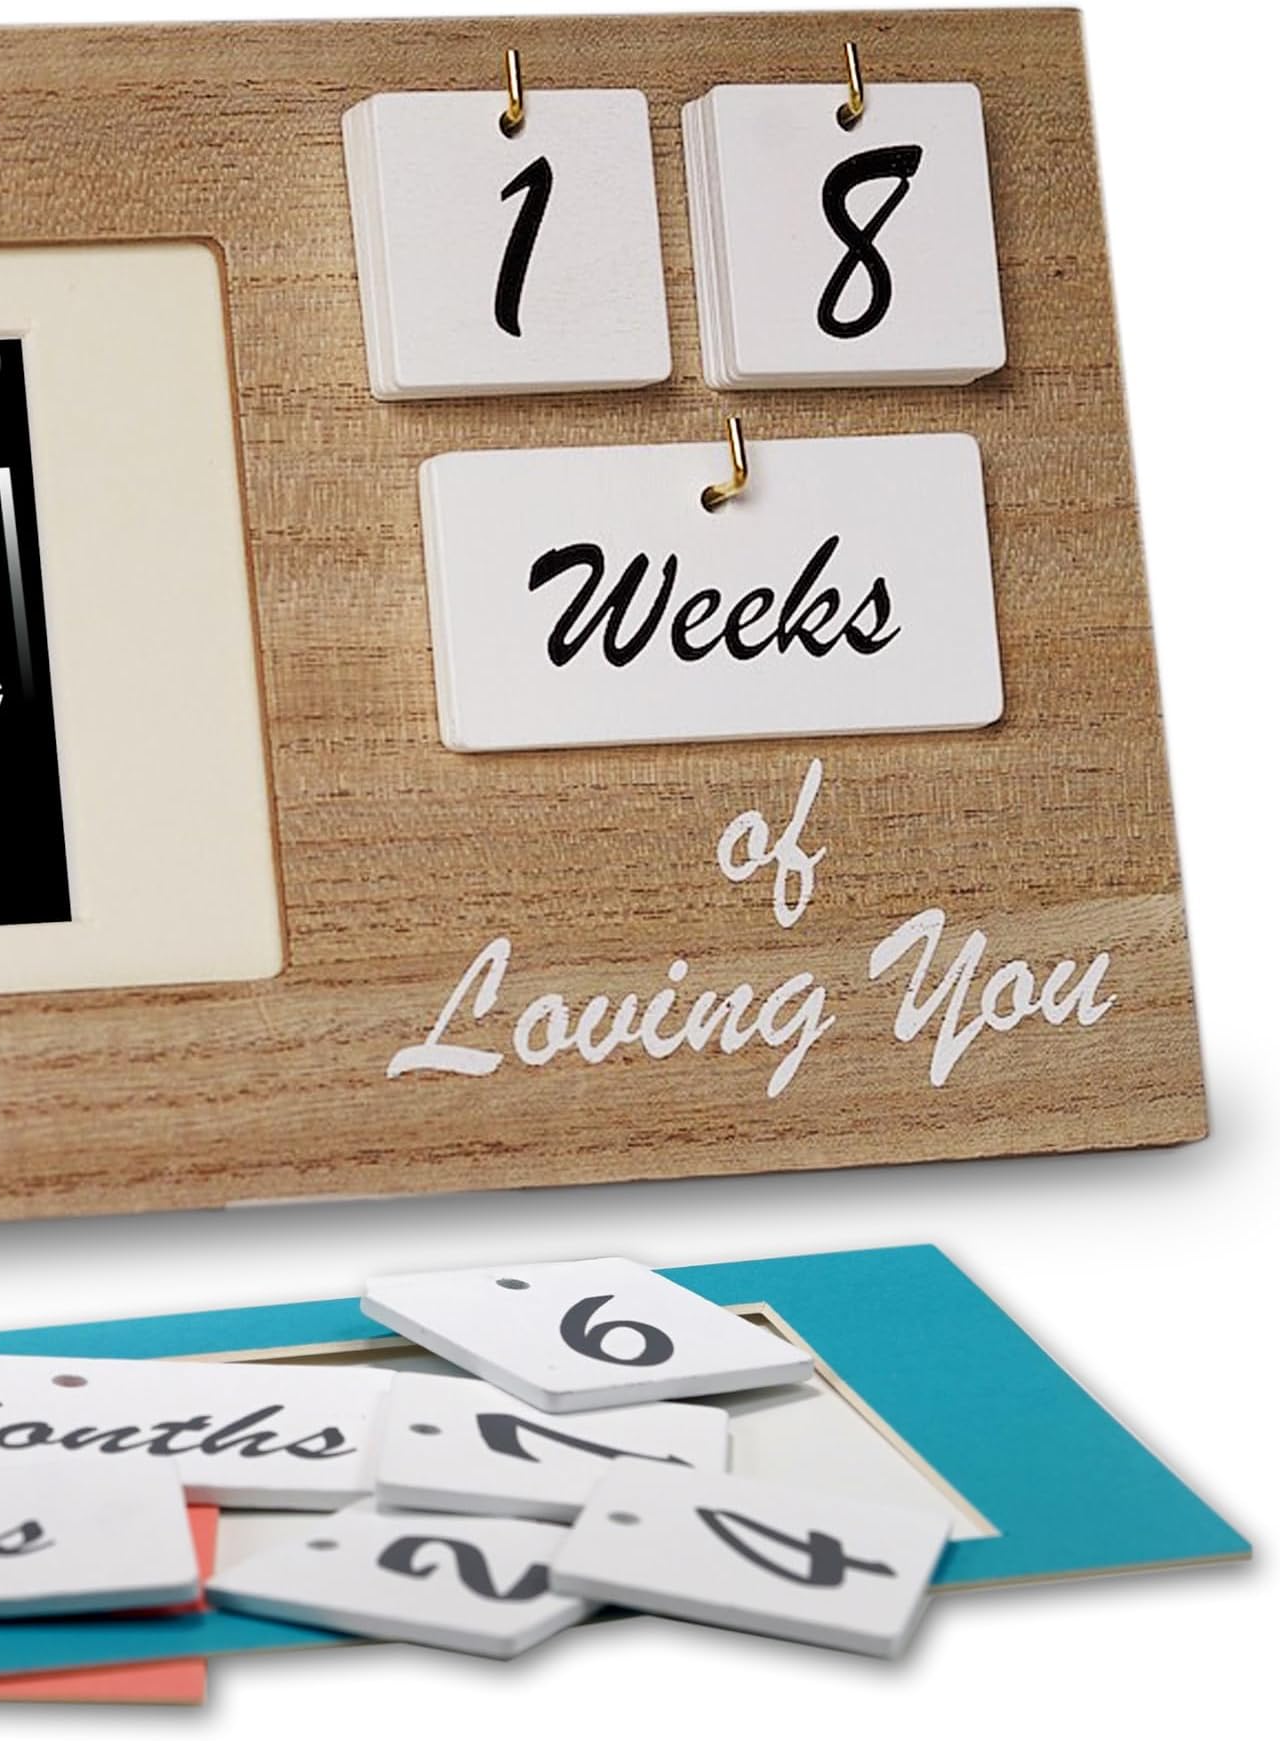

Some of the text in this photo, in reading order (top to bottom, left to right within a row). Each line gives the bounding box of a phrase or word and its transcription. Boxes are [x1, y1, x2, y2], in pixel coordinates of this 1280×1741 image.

[494, 156, 554, 338] 1
[817, 144, 923, 339] 8
[528, 535, 901, 668] Weeks
[716, 757, 826, 928] of
[387, 907, 1118, 1098] Loving You
[559, 1294, 675, 1367] 6
[696, 1506, 899, 1588] 4
